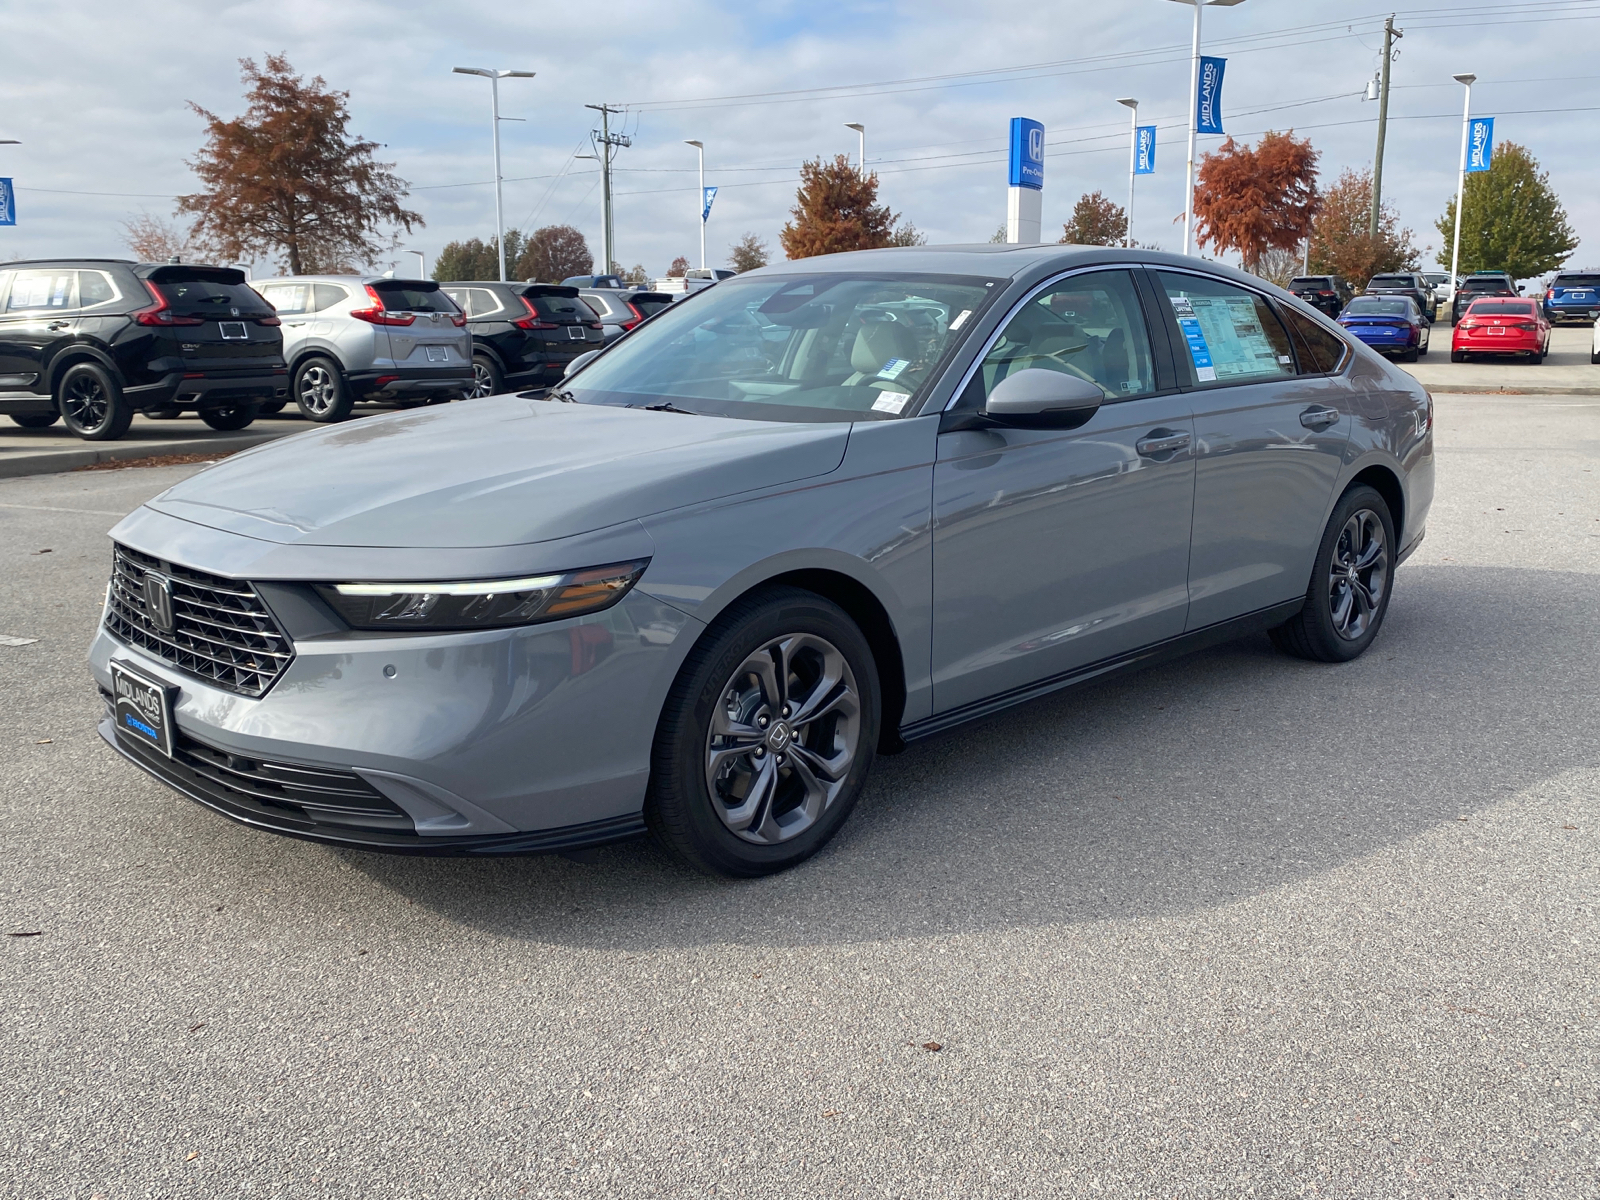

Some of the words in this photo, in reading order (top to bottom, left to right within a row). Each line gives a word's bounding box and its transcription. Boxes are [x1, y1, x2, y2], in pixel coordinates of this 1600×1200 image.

[1202, 63, 1213, 126] MIDLANDS
[1139, 129, 1148, 170] MIDLANDS
[1471, 122, 1483, 167] MIDLANDS
[115, 675, 160, 715] MIDLANDS
[133, 718, 157, 740] HONDA
